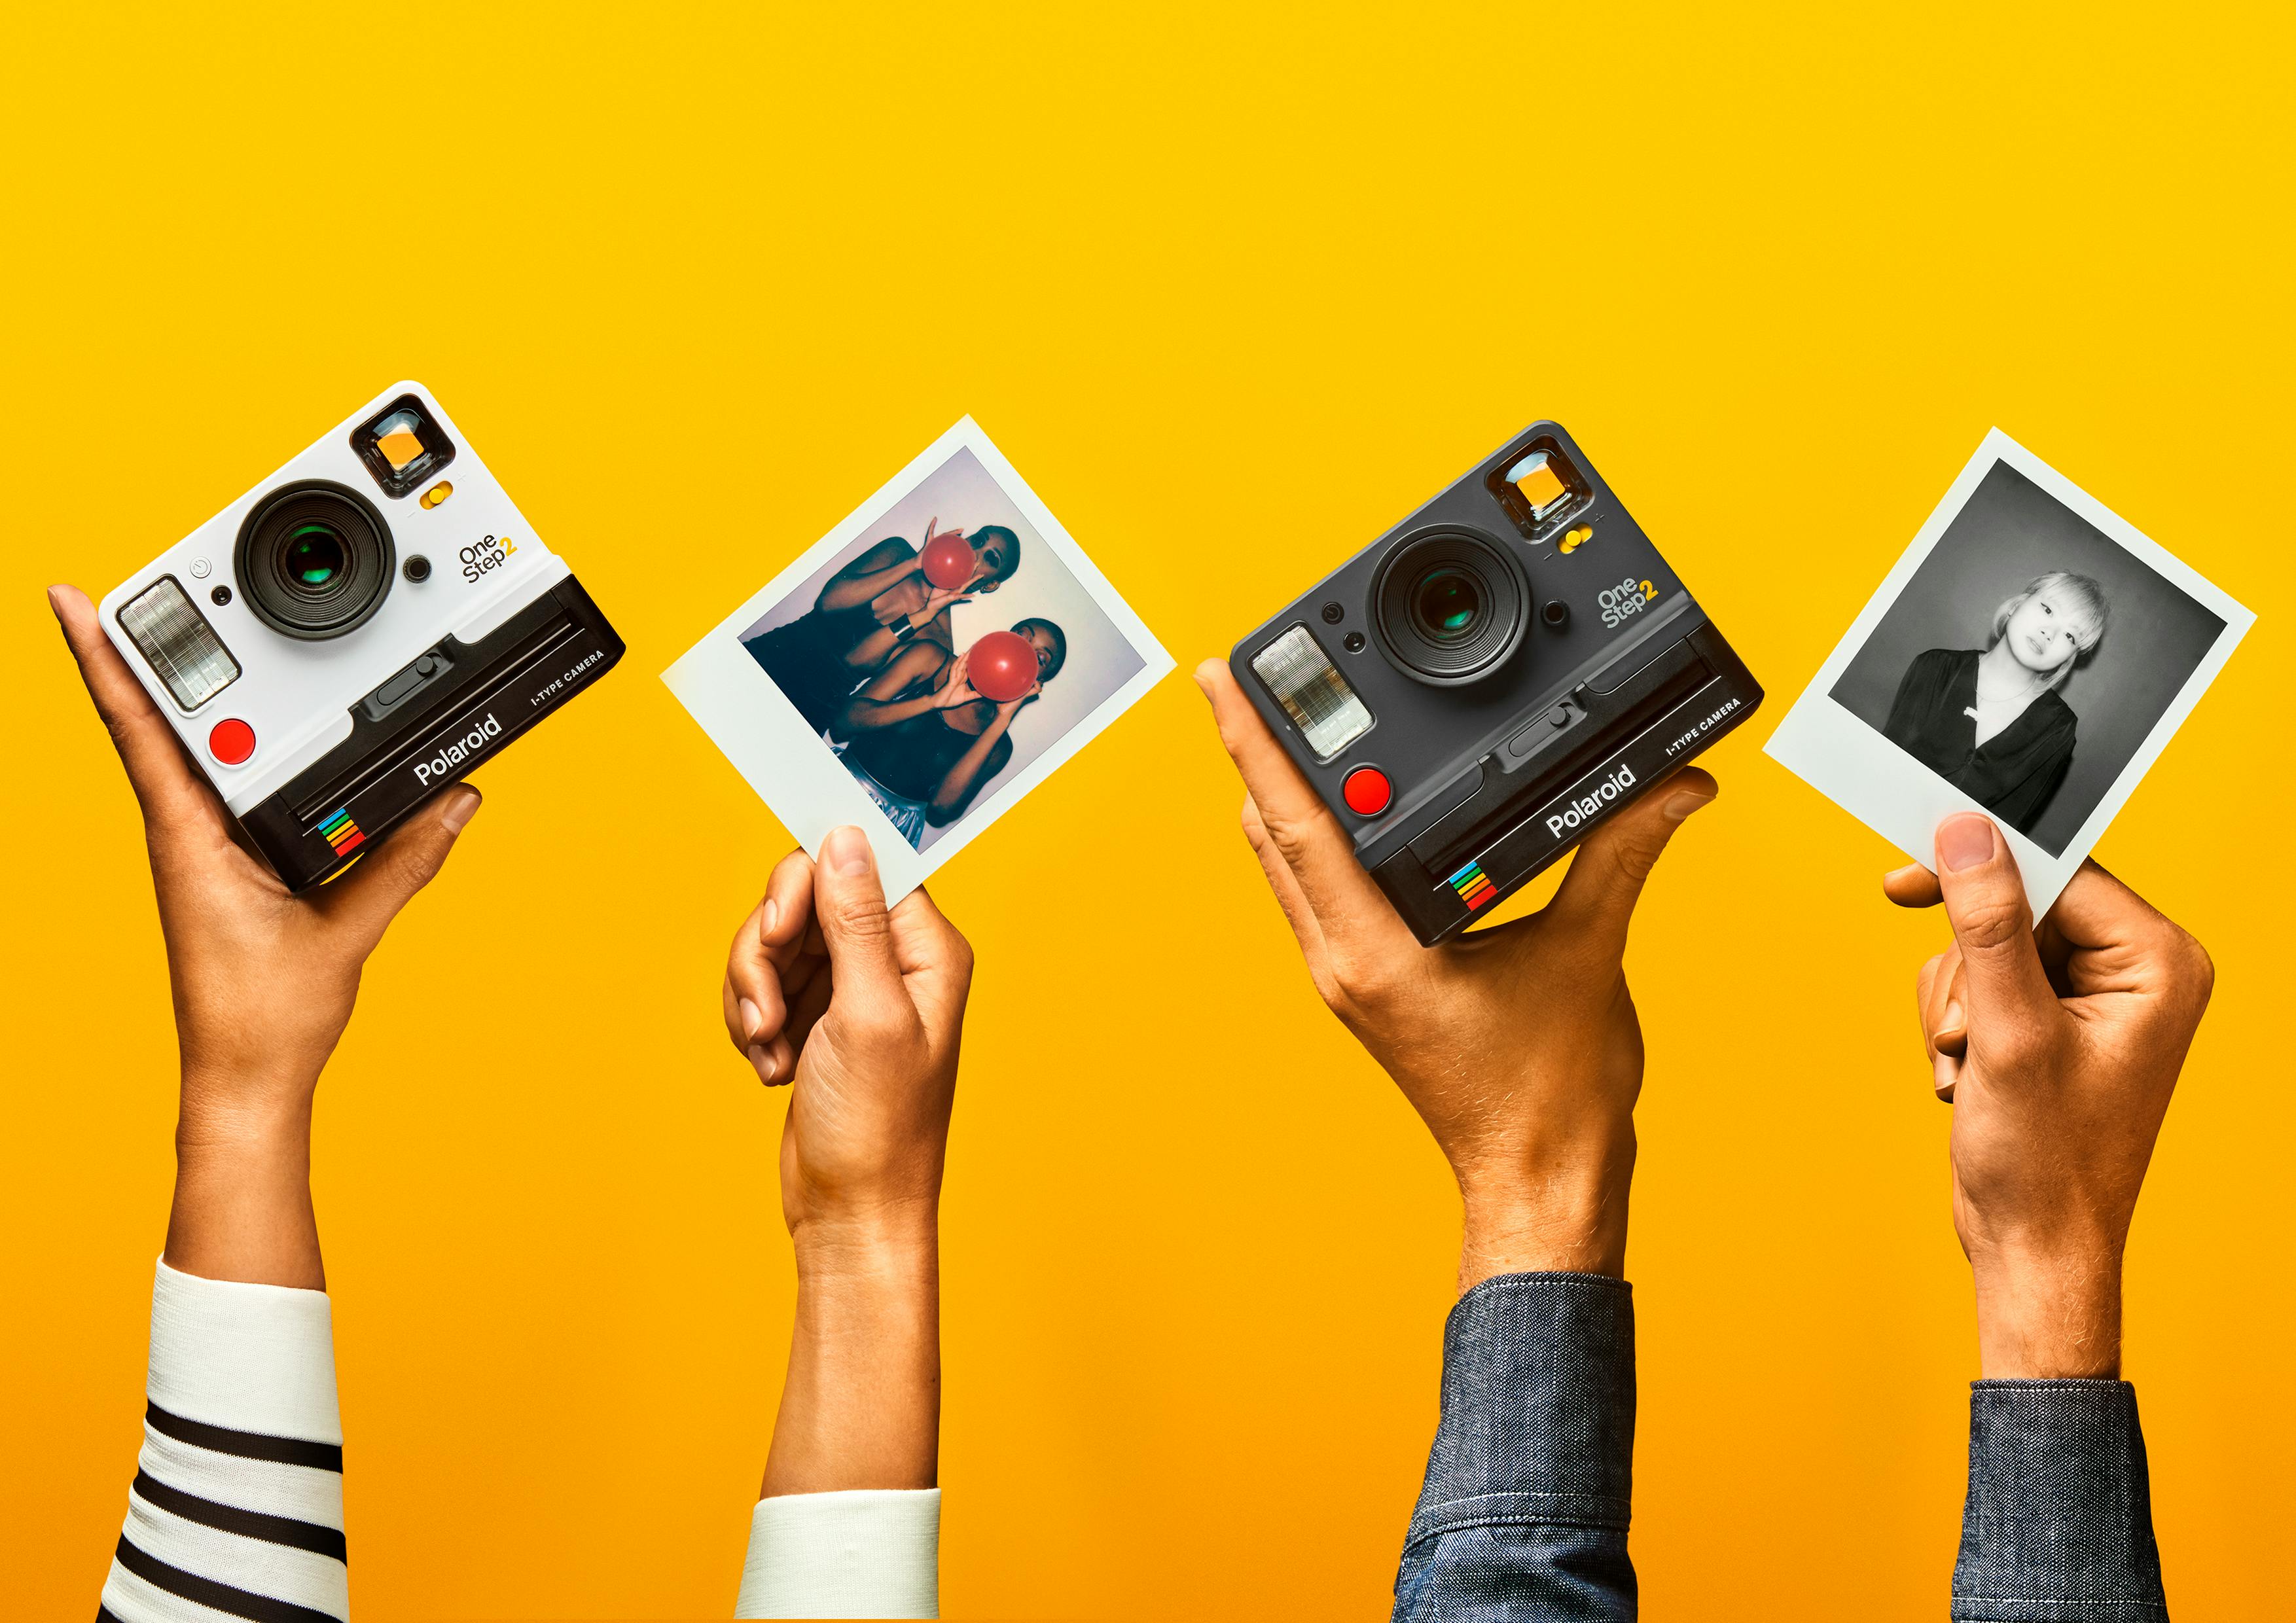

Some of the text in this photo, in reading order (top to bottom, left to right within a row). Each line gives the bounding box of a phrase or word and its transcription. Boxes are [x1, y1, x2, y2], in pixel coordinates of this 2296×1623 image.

[459, 535, 497, 565] One
[1598, 578, 1638, 609] One
[530, 650, 604, 706] I-TYPE CAMERA
[413, 713, 503, 786] Polaroid
[1665, 698, 1741, 757] I-TYPE CAMERA
[1545, 763, 1638, 839] Polaroid
